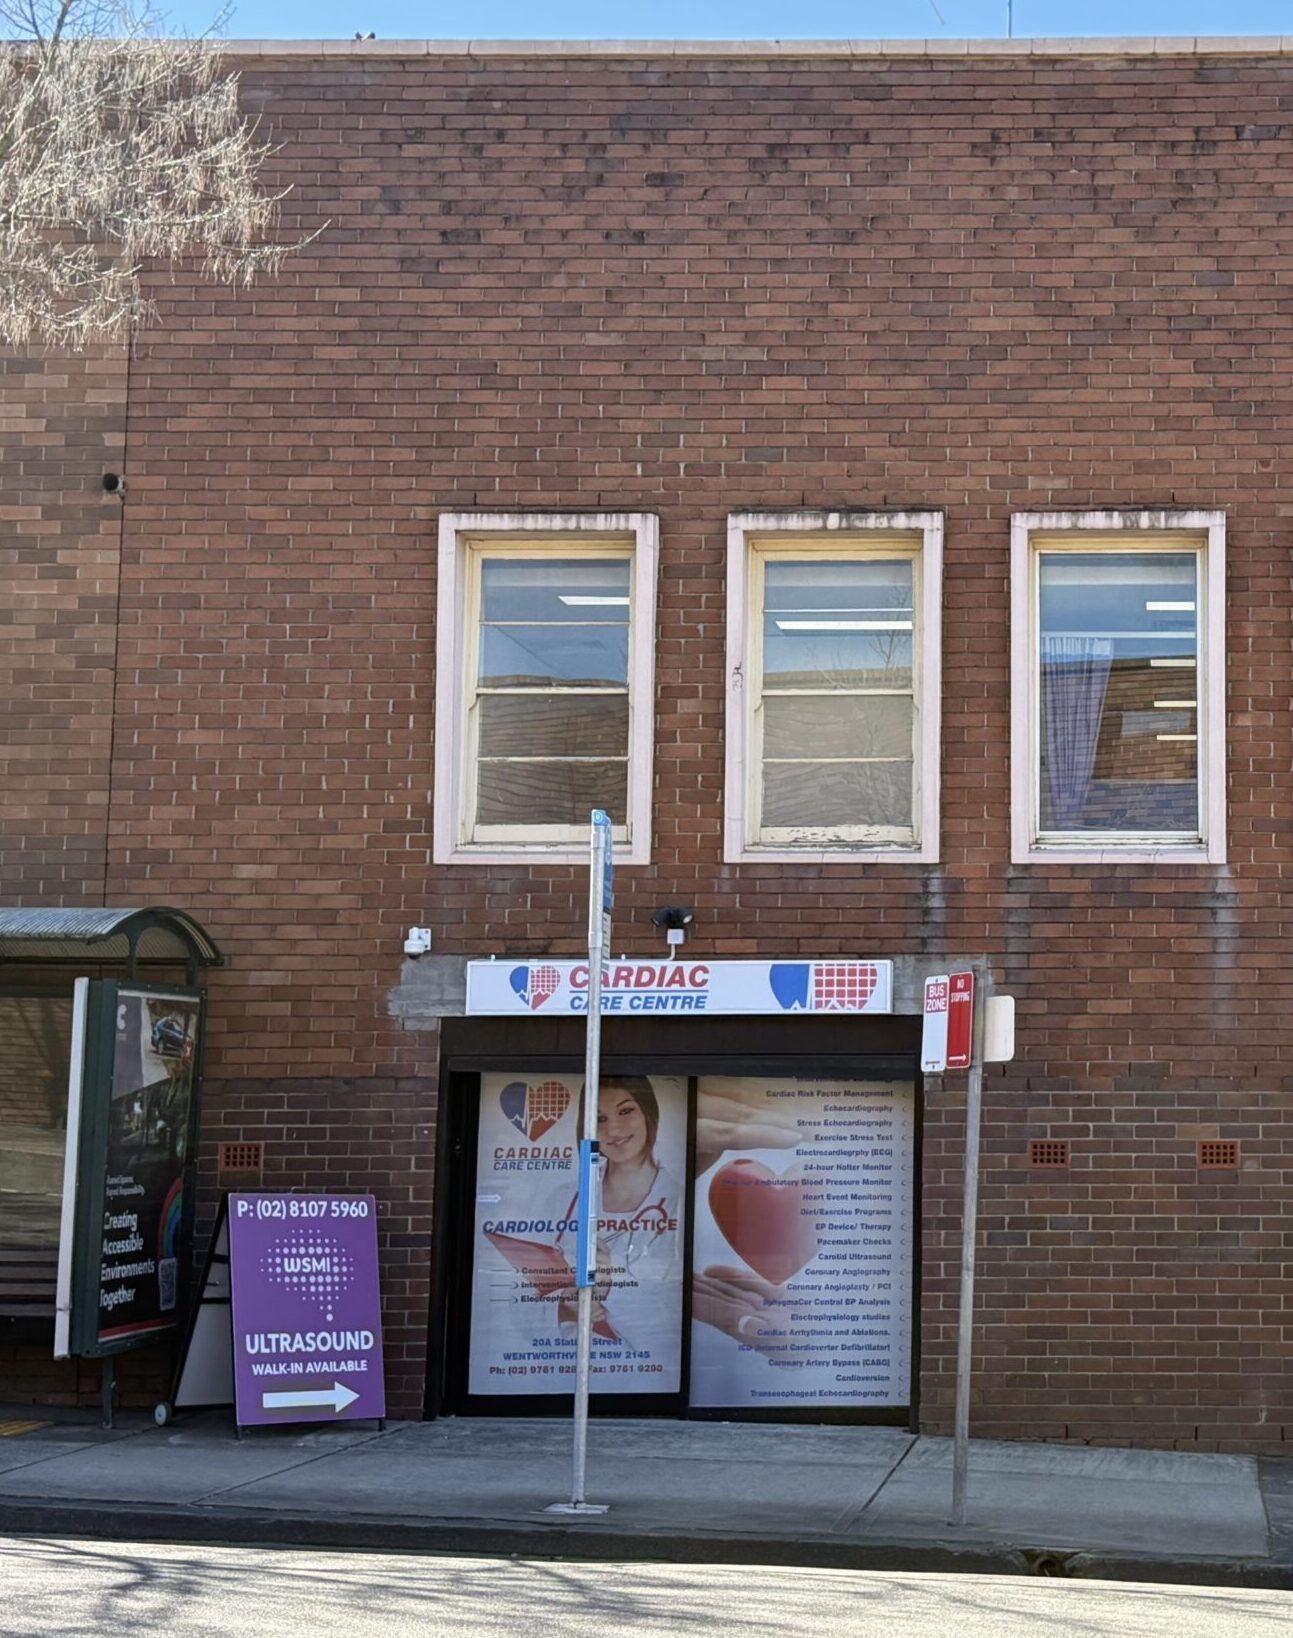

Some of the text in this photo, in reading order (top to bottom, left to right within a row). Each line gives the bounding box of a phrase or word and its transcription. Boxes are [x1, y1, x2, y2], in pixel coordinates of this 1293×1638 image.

[957, 979, 965, 989] NO
[929, 985, 945, 996] BUS
[951, 991, 970, 1003] STOPPING
[629, 995, 706, 1010] CENTRE
[926, 998, 946, 1011] ZONE
[766, 1090, 795, 1098] Cardiac
[844, 1090, 893, 1098] Management
[824, 1105, 893, 1113] Echocardiography
[797, 1119, 892, 1128] Stress Echocardiography
[814, 1134, 848, 1142] Exercise
[850, 1134, 874, 1142] Stress
[494, 1147, 573, 1159] CARDIAC
[493, 1160, 572, 1170] CARE CENTRE
[862, 1163, 892, 1171] Monitor
[801, 1178, 823, 1186] Blood
[826, 1178, 859, 1186] Pressure
[862, 1178, 892, 1186] Monitor
[802, 1193, 892, 1202] Heart Event Monitoring
[237, 1200, 368, 1219] P: (02) 8107 5960
[855, 1208, 892, 1217] Programs
[104, 1210, 138, 1232] Creating
[482, 1218, 678, 1233] CARDIOLOG PRACTICE
[860, 1223, 891, 1232] Therapy
[102, 1233, 144, 1255] Accessible
[817, 1238, 892, 1246] Pacemaker Checks
[818, 1253, 891, 1261] Carotid Ultrasound
[101, 1258, 155, 1281] Environments
[521, 1266, 568, 1274] Consultant
[805, 1268, 890, 1277] Coronary Angiography
[787, 1283, 821, 1292] Coronary
[824, 1283, 869, 1292] Angioplasty
[100, 1284, 136, 1311] Together
[814, 1298, 843, 1306] Central
[858, 1298, 890, 1307] Analysis
[789, 1329, 832, 1338] Arrhythmia
[246, 1330, 374, 1354] ULTRASOUND
[532, 1338, 622, 1346] 20A Stati Street
[503, 1352, 596, 1361] WENTWORTHVIE
[600, 1351, 622, 1360] NSW
[252, 1360, 368, 1376] WALK-IN AVAILABLE
[768, 1359, 803, 1368] Coronary
[806, 1359, 830, 1368] Artery
[832, 1359, 860, 1368] Bypass
[489, 1367, 505, 1375] Ph:
[508, 1366, 527, 1376] (02)
[836, 1374, 890, 1382] Cardioversion
[818, 1389, 889, 1398] Echocardiography
